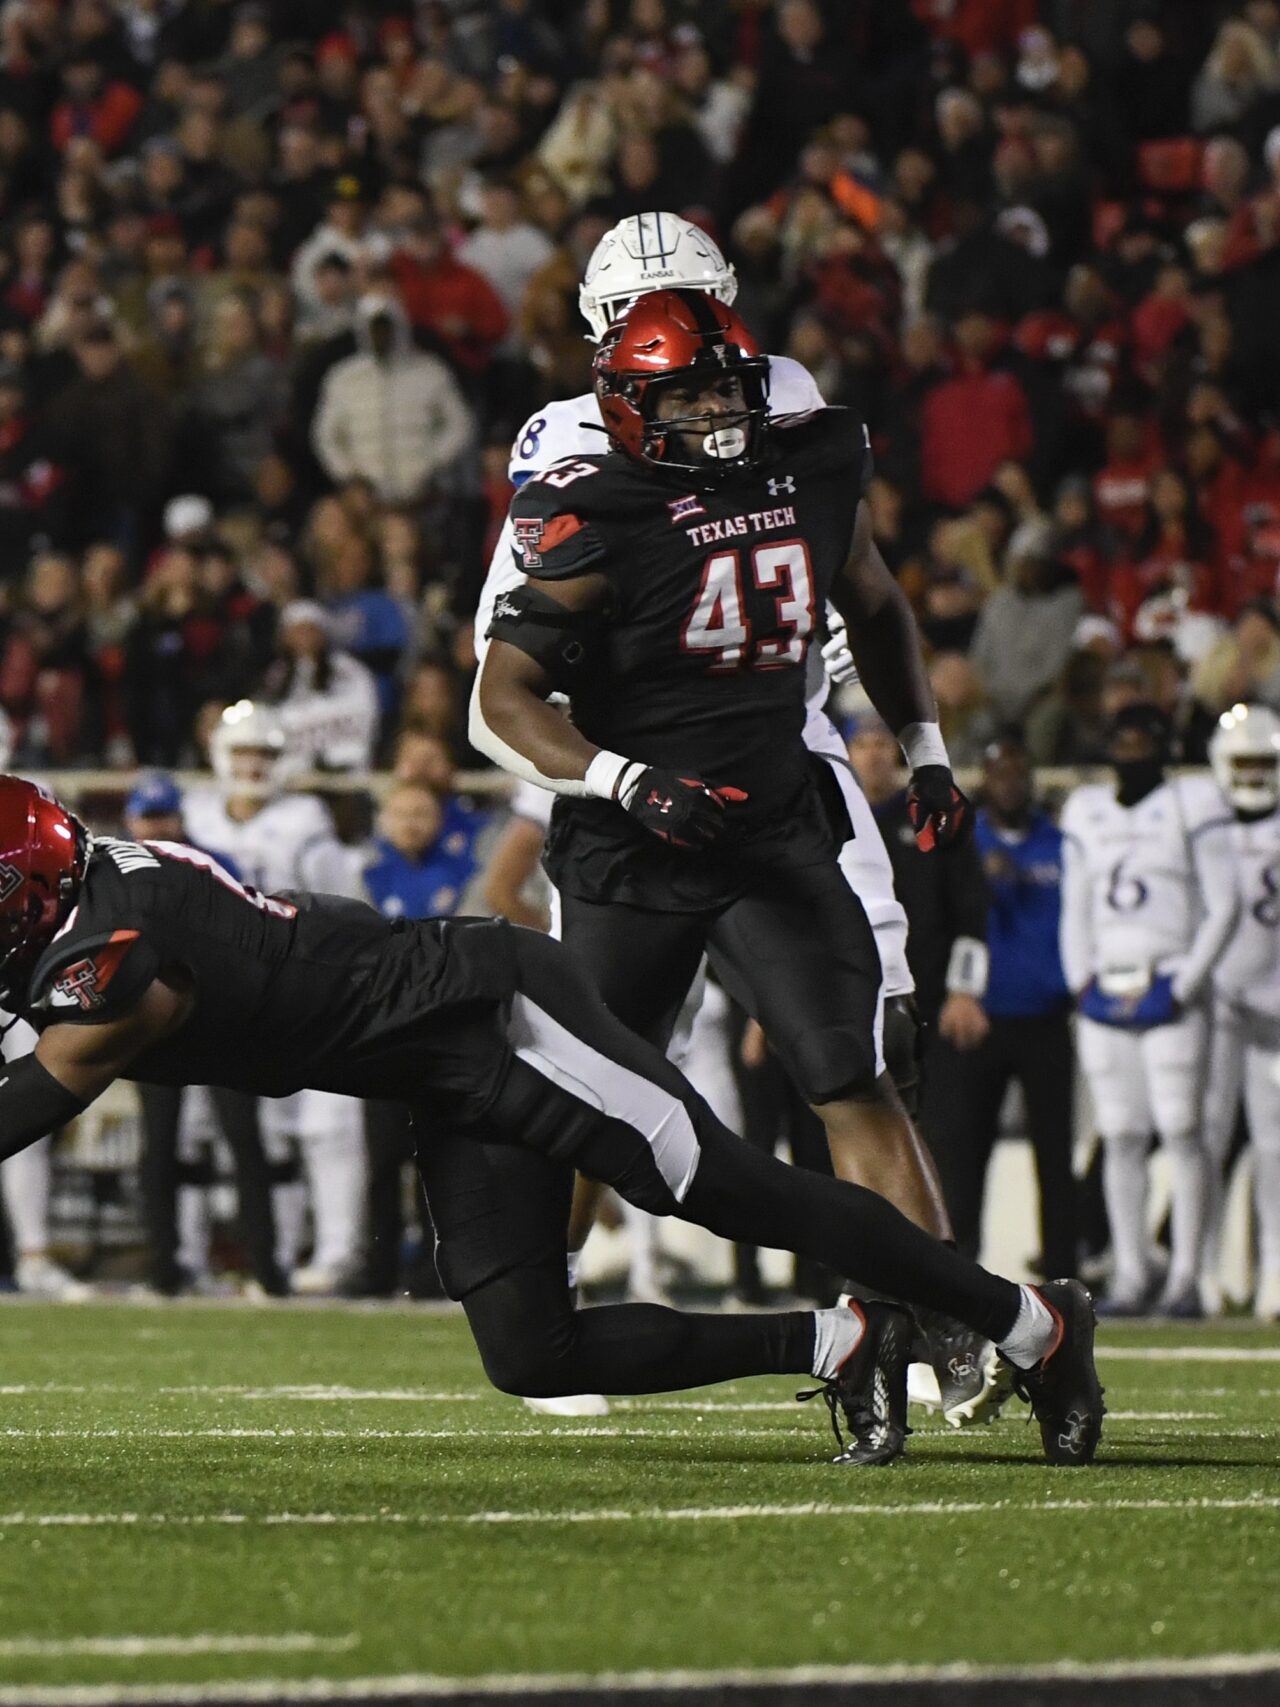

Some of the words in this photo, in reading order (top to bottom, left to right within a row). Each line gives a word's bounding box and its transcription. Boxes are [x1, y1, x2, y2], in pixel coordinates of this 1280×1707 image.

[520, 418, 547, 460] 8
[686, 515, 748, 546] TEXAS
[748, 506, 797, 532] TECH
[679, 538, 817, 673] 43
[1106, 855, 1148, 913] 6
